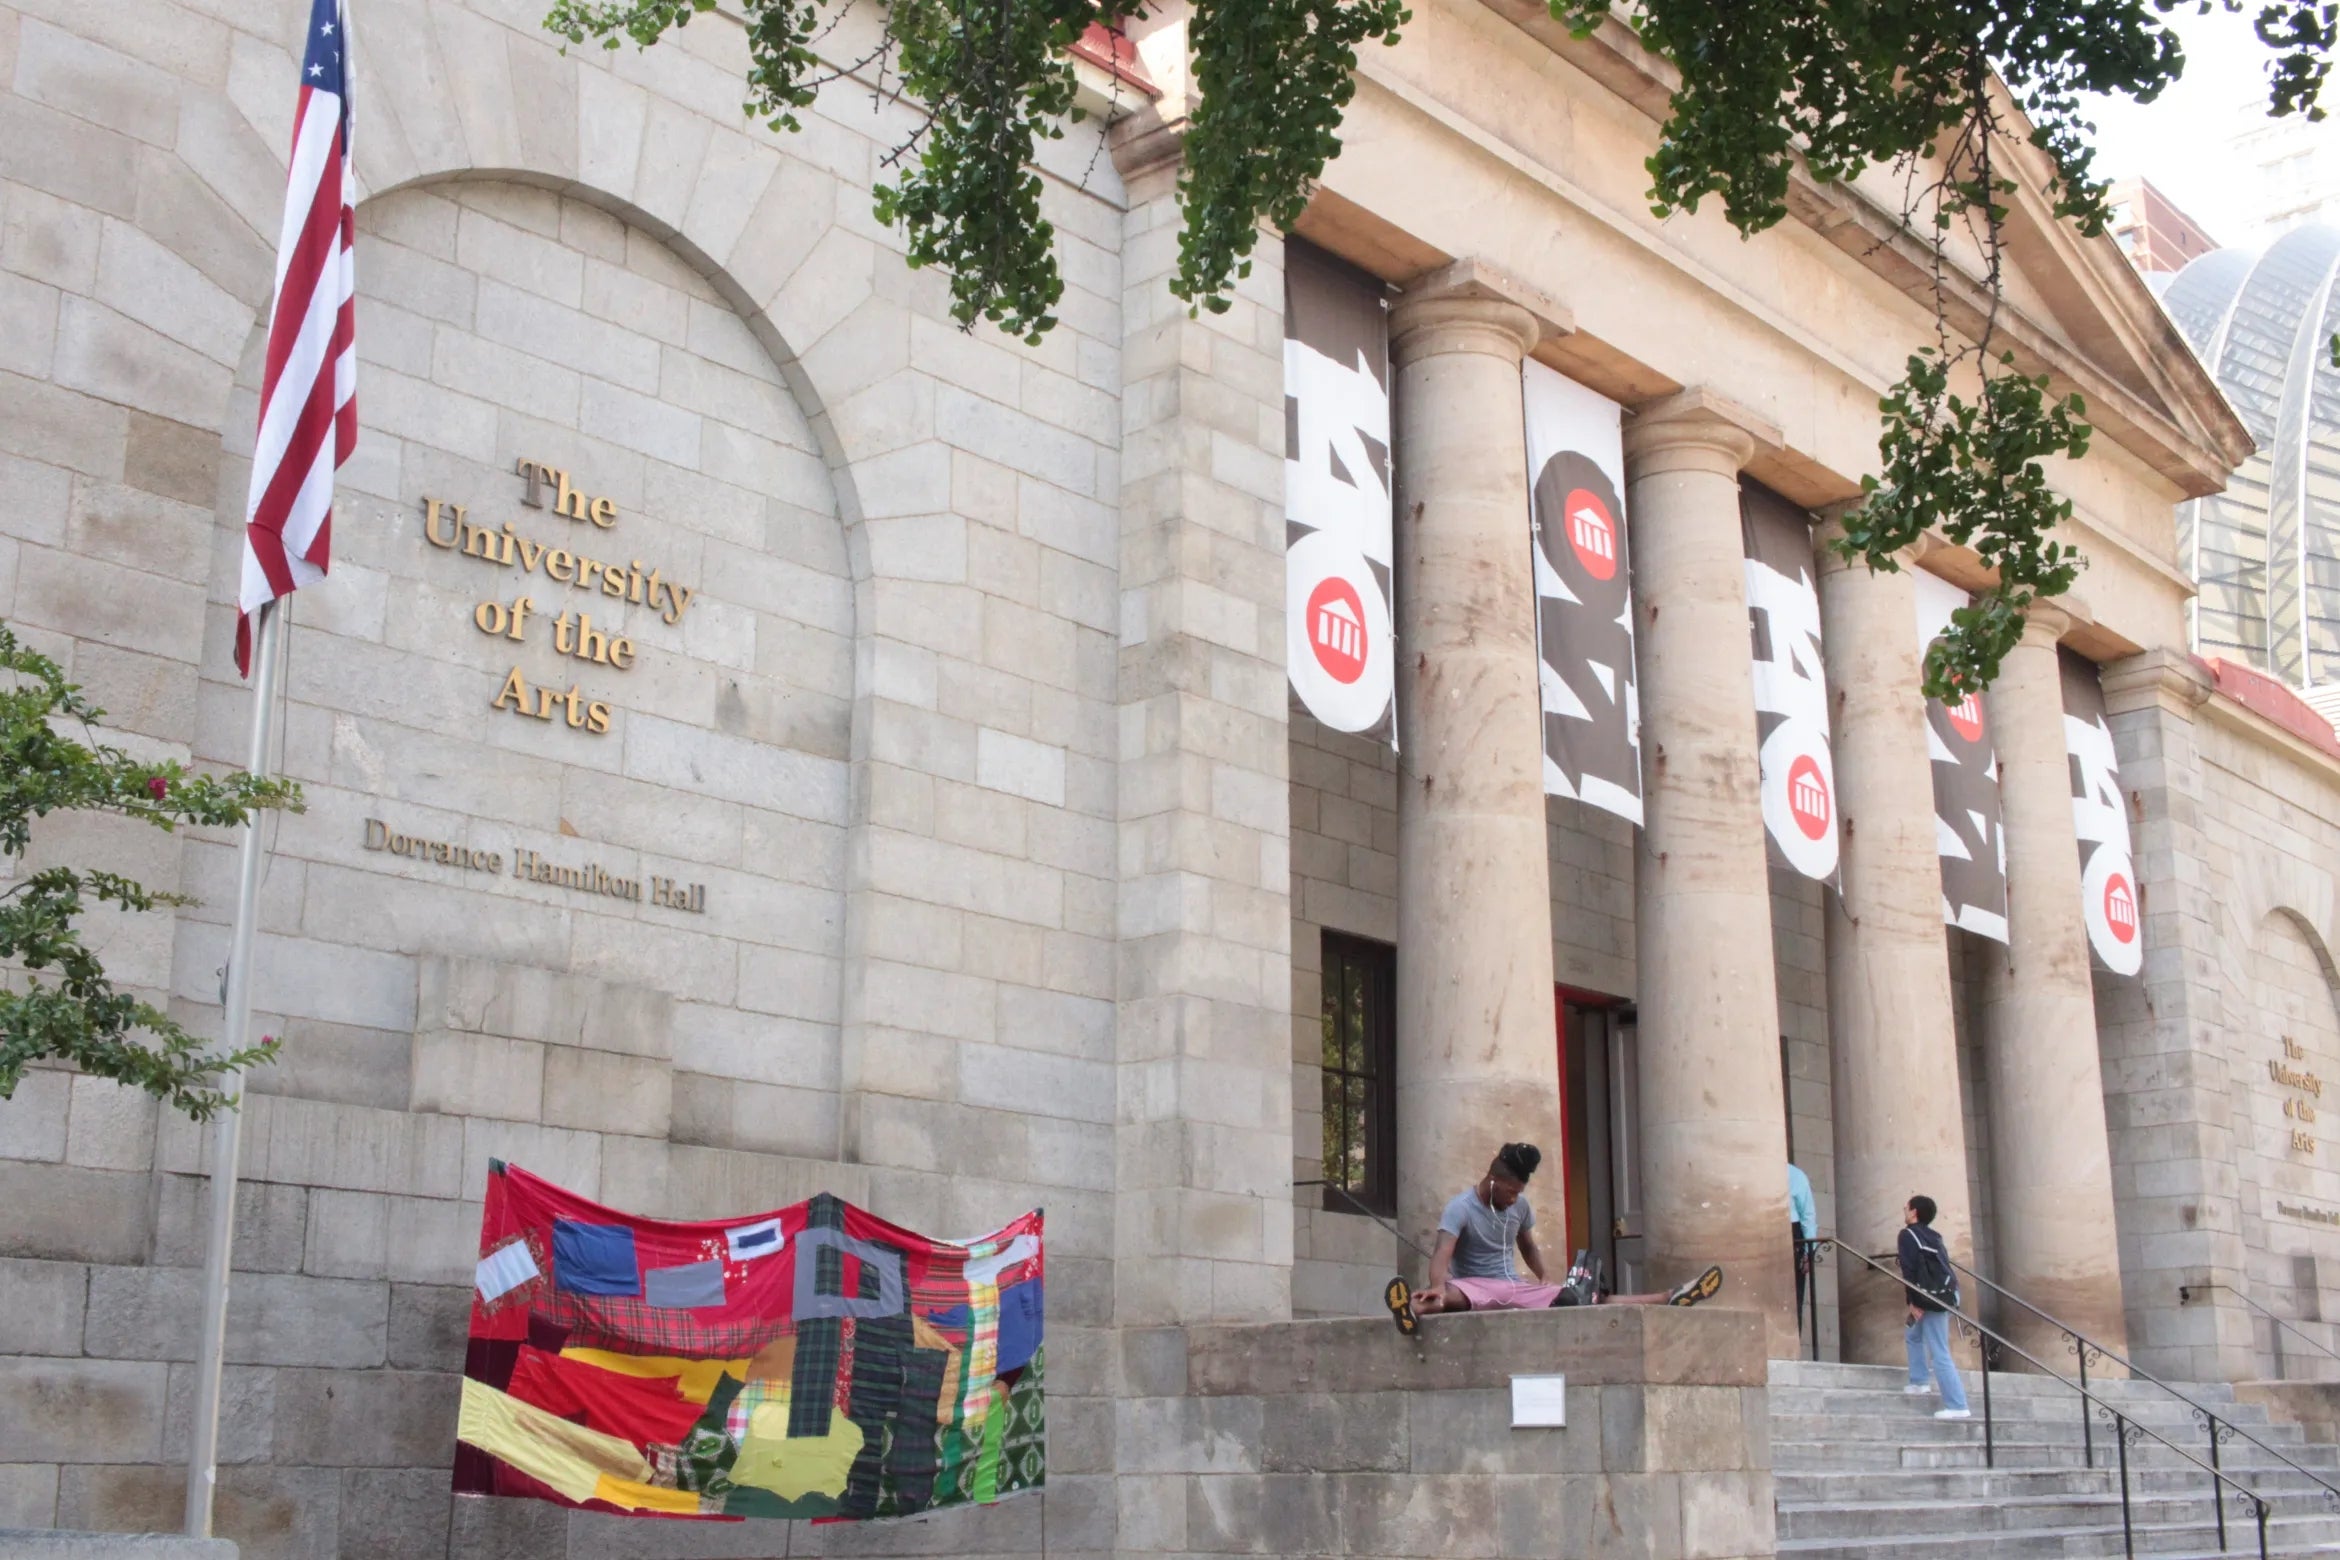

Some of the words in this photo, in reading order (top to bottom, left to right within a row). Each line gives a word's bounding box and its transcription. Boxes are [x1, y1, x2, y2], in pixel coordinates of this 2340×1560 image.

[516, 457, 617, 528] The
[422, 496, 696, 625] University
[474, 597, 533, 642] of
[553, 611, 637, 670] the
[491, 665, 613, 734] Arts
[364, 817, 503, 874] Dorrance
[513, 848, 645, 901] Hamilton
[651, 875, 706, 914] Hall
[2268, 1059, 2322, 1099] University
[2291, 1127, 2315, 1154] Arts
